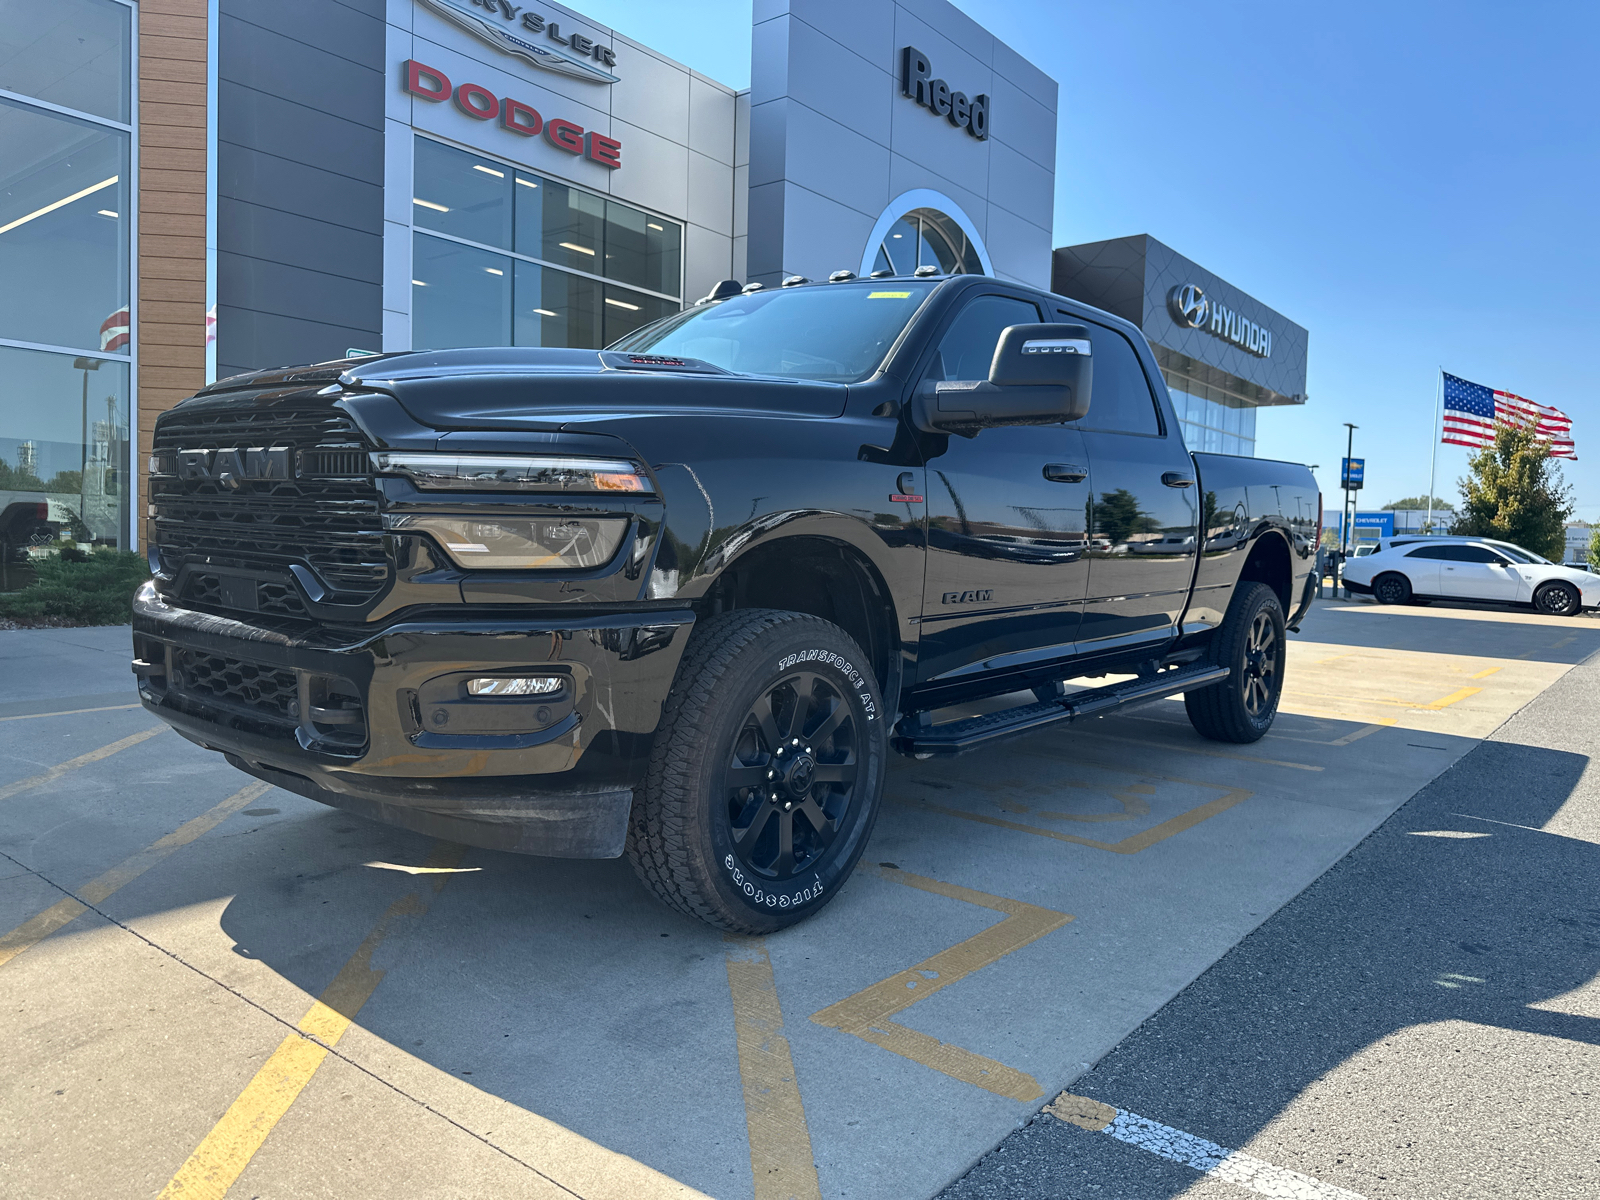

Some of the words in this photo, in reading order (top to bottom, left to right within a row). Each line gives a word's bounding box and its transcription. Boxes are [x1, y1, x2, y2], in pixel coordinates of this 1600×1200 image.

[472, 0, 617, 66] YSLER
[403, 59, 621, 169] DODGE
[902, 45, 990, 141] Reed
[1211, 301, 1272, 358] HYUNDAI
[178, 446, 289, 481] RAM
[941, 589, 994, 604] RAM
[778, 649, 865, 689] TRANSFORCE
[725, 854, 824, 907] Firestone
